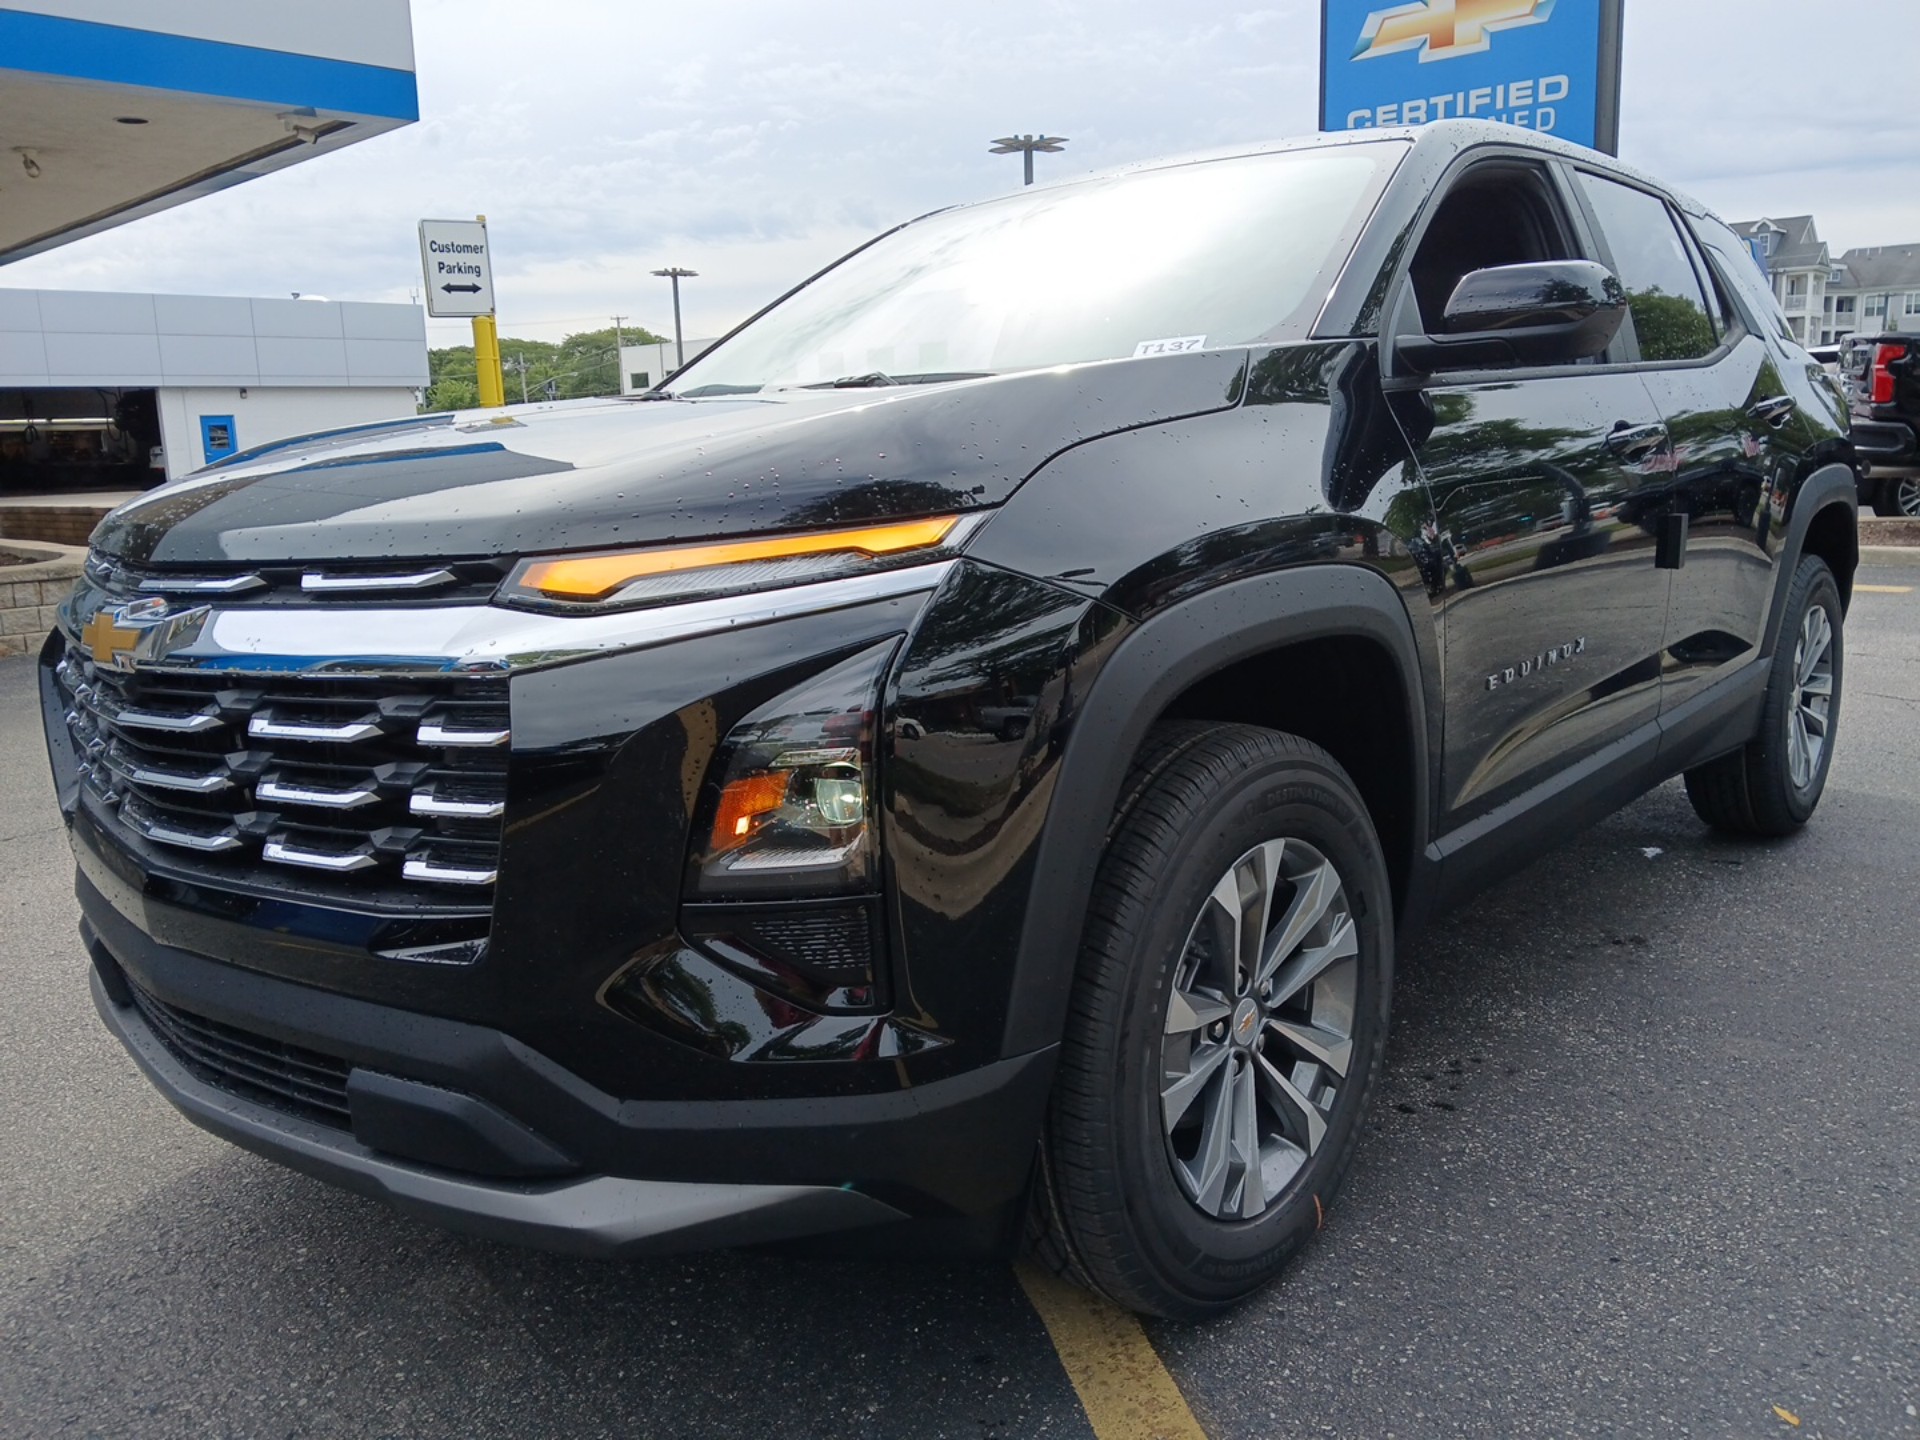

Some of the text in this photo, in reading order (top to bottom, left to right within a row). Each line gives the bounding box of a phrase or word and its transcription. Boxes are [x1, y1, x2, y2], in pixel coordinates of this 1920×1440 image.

[1346, 73, 1569, 129] CERTIFIED
[429, 240, 485, 254] Customer
[437, 261, 482, 278] Parking
[1140, 339, 1201, 355] T137
[1486, 636, 1585, 692] EQUINOX
